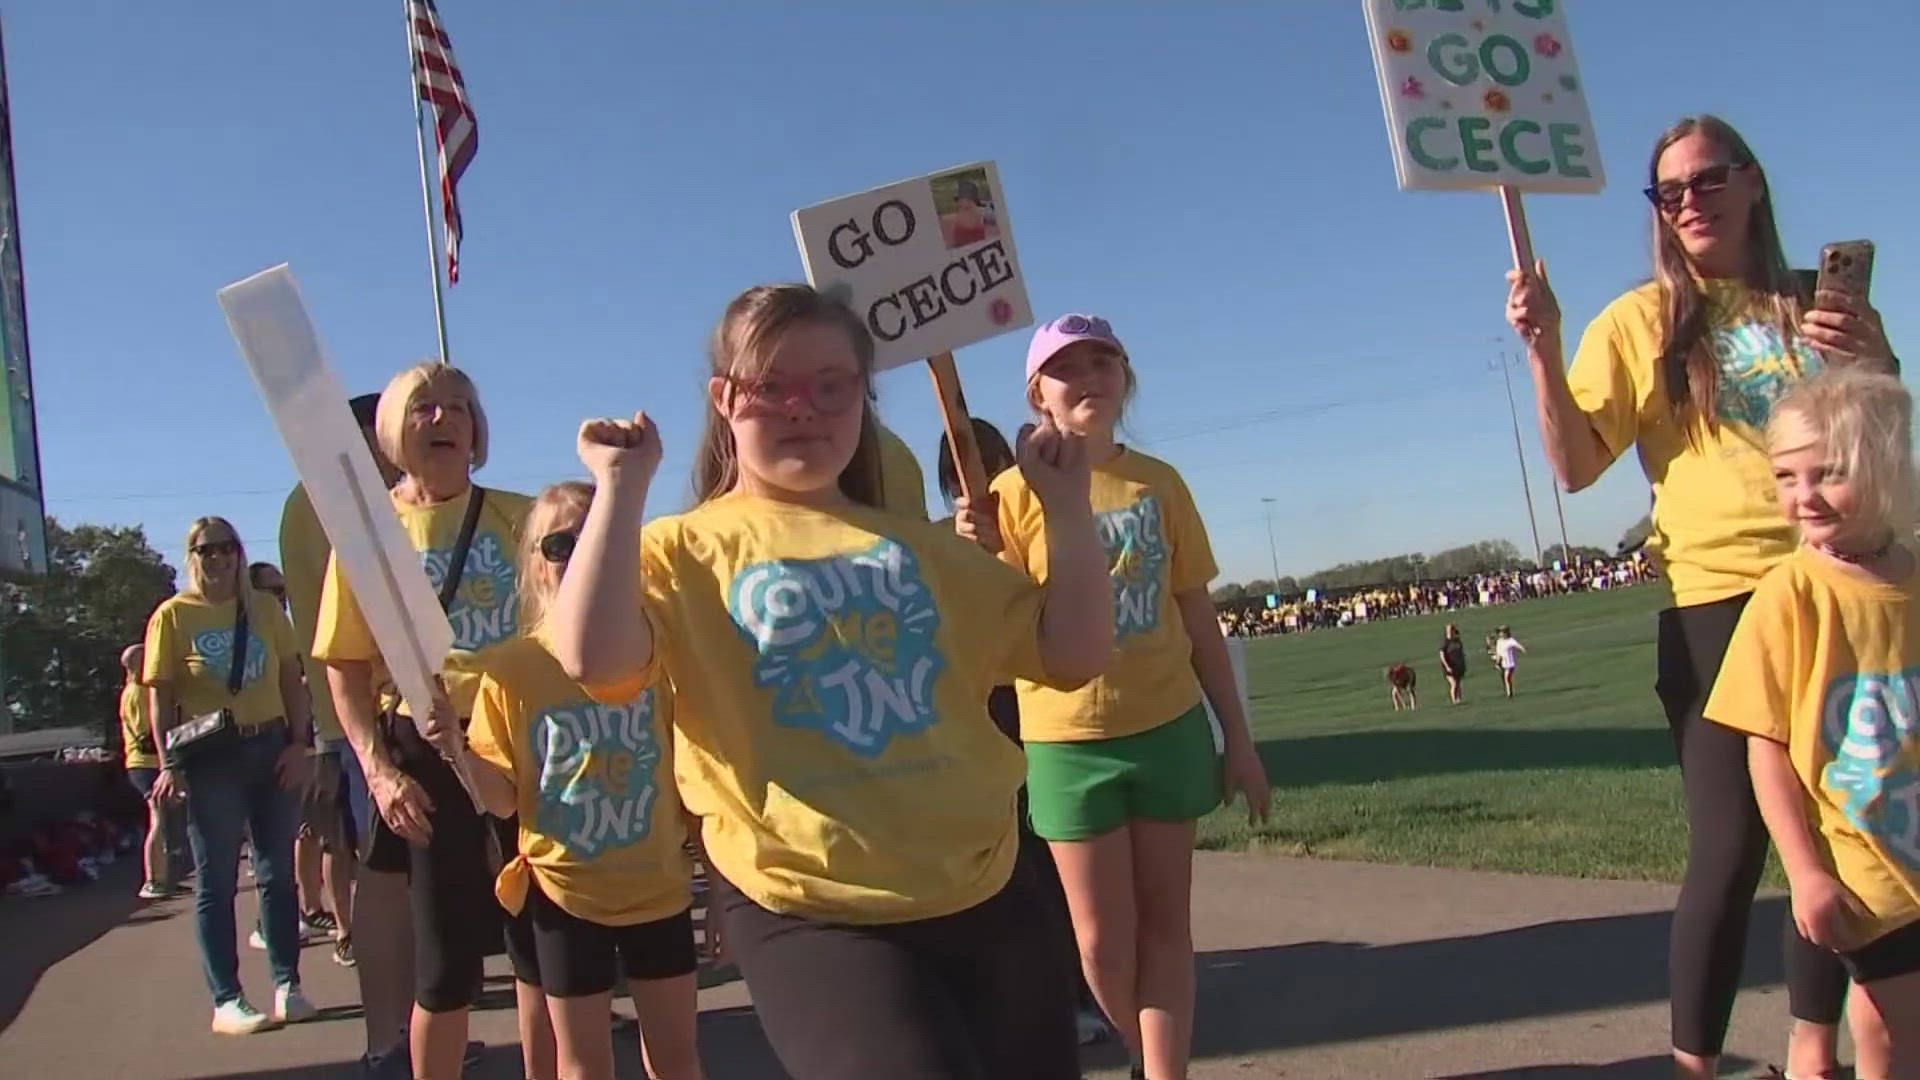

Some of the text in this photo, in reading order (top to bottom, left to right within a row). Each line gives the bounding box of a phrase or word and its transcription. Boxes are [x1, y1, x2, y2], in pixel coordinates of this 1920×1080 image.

[1427, 32, 1530, 87] GO
[1405, 116, 1593, 178] CECE
[828, 200, 916, 269] GO
[867, 240, 1014, 342] CECE
